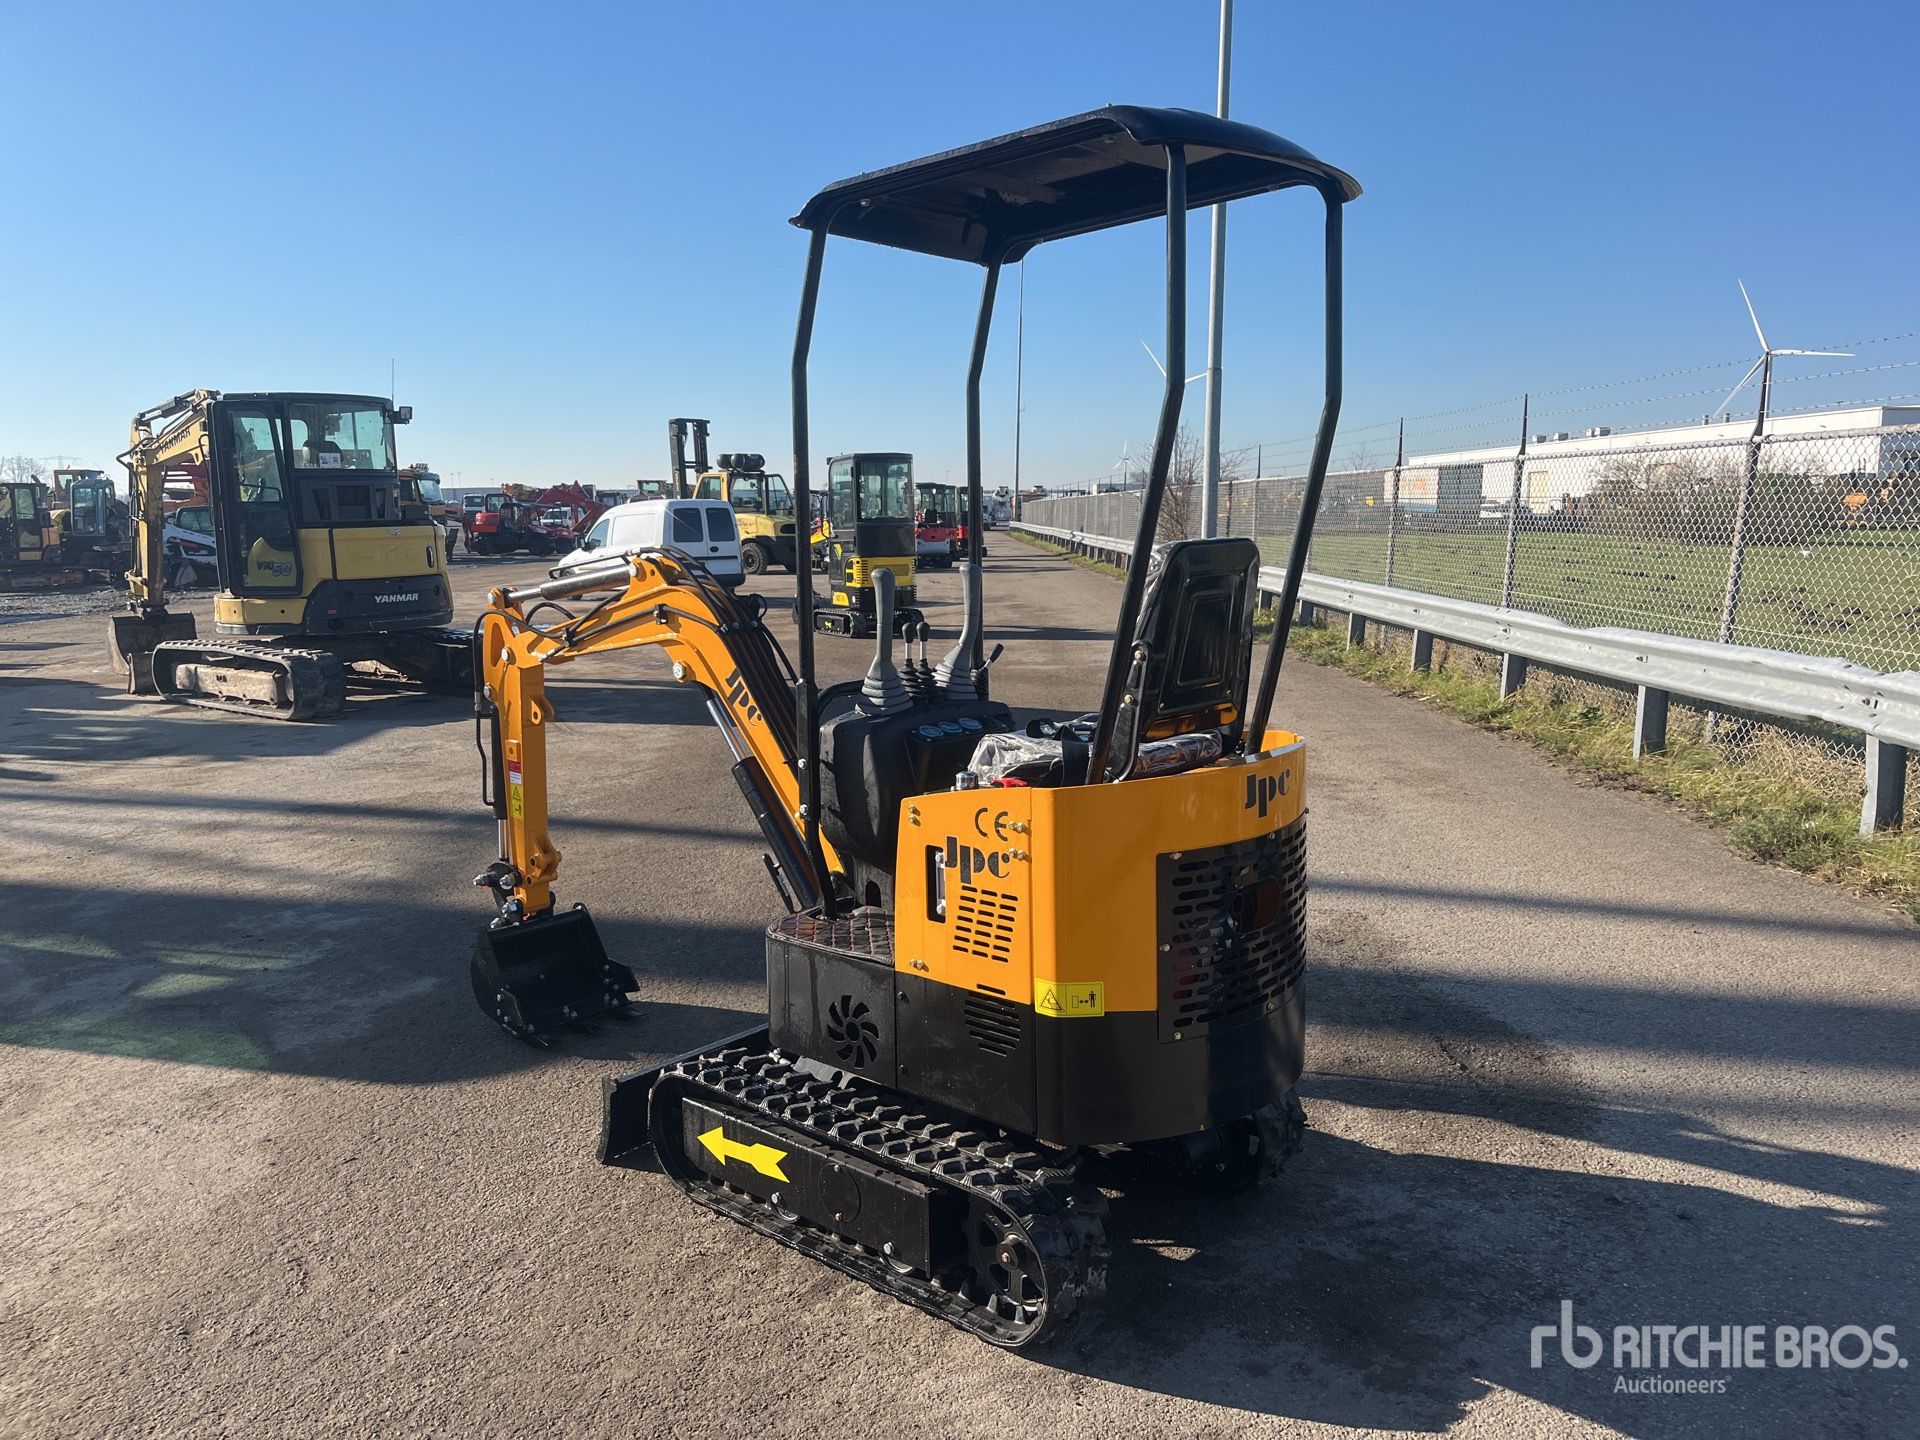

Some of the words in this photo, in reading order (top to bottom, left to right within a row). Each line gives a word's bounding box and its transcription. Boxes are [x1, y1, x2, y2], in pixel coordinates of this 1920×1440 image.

[160, 426, 190, 454] YANMAR
[374, 593, 419, 604] YANMAR
[975, 807, 1009, 842] CE
